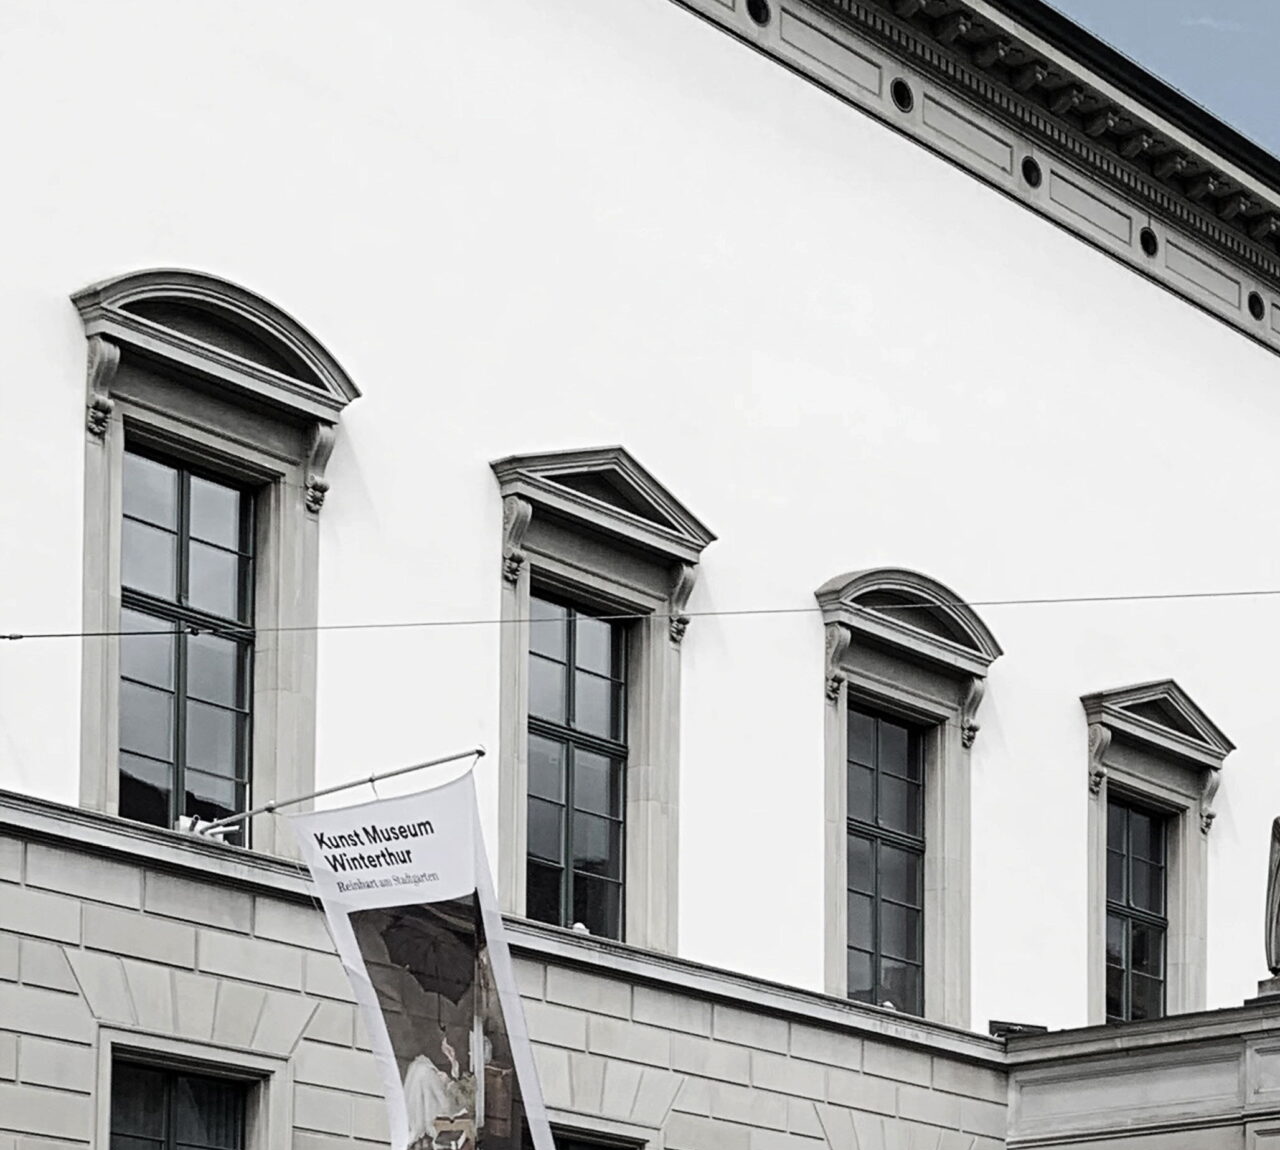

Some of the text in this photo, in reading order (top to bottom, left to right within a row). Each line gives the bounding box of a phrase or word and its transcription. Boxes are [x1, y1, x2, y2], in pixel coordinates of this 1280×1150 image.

[313, 819, 435, 850] Kunst Museum
[324, 848, 413, 873] Winterthur
[336, 876, 379, 893] Reinhart
[393, 871, 440, 888] Stadtgarten
